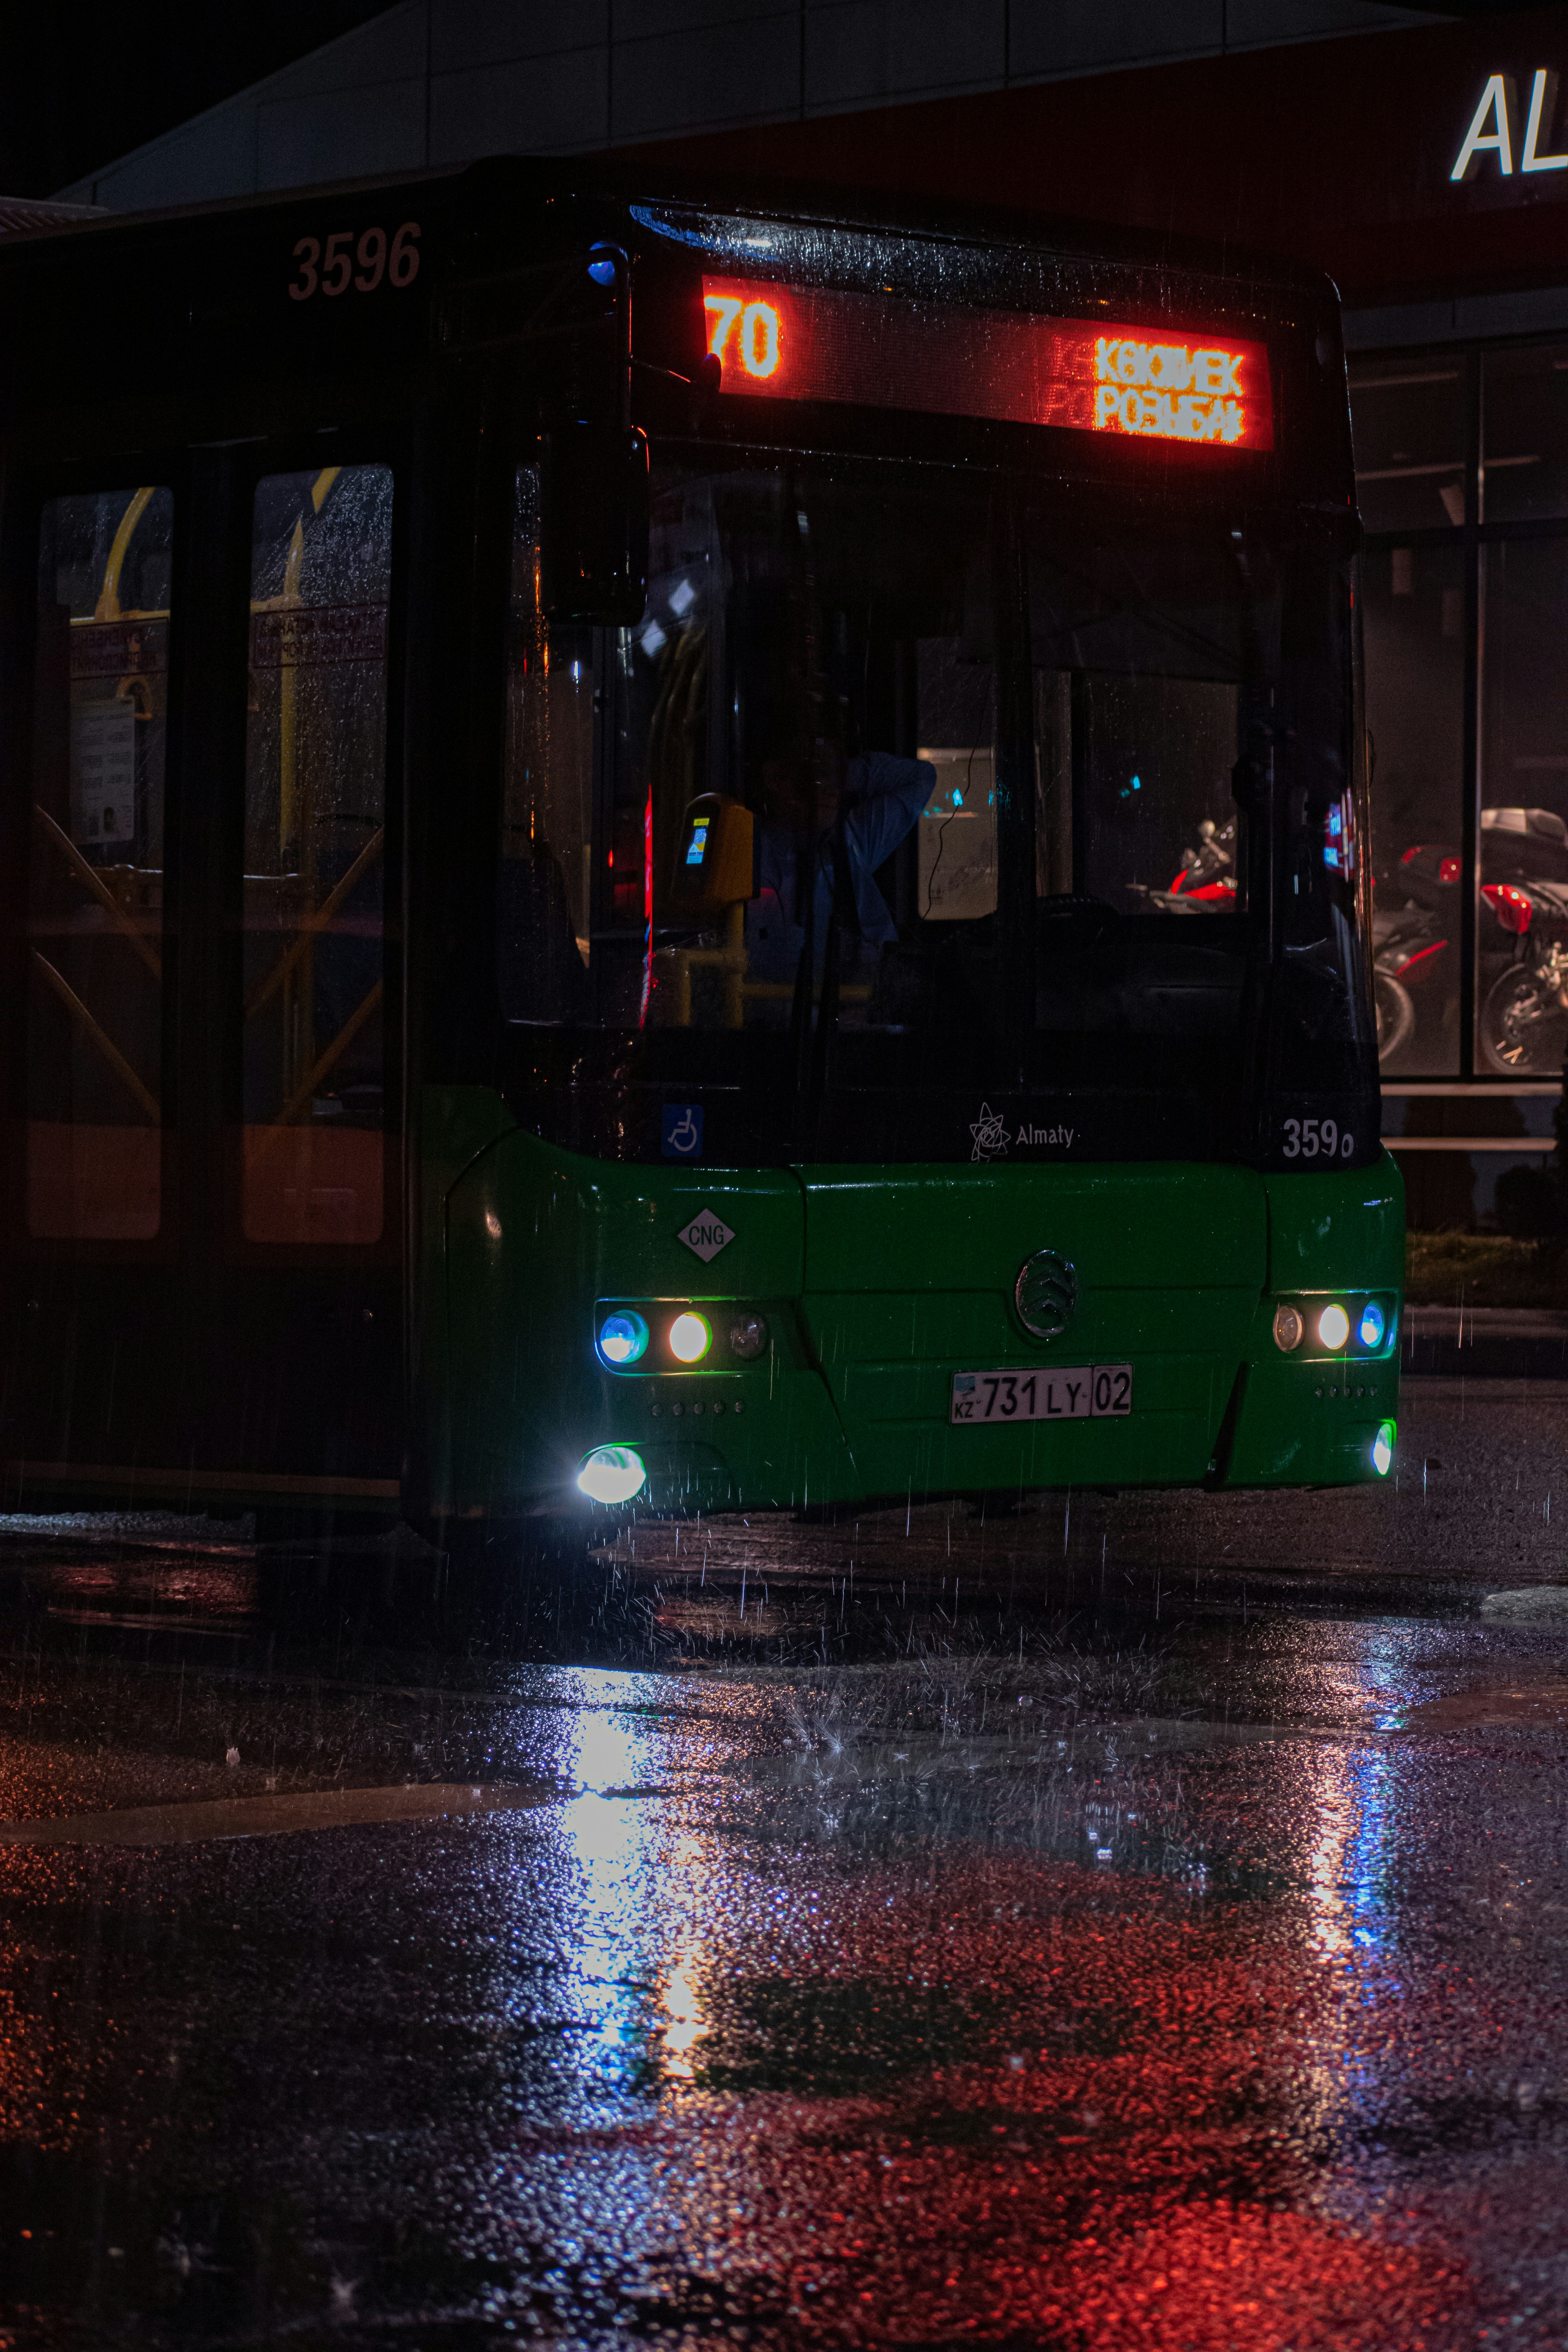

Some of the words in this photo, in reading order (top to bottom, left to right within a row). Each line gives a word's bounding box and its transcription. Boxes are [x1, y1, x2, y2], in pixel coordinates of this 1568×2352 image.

[1450, 67, 1568, 181] AL
[288, 221, 423, 301] 3596
[704, 296, 779, 379] 70
[1015, 1123, 1074, 1148] Almaty
[689, 1225, 724, 1245] CNG
[954, 1402, 975, 1418] KZ
[1096, 1372, 1131, 1410] 02
